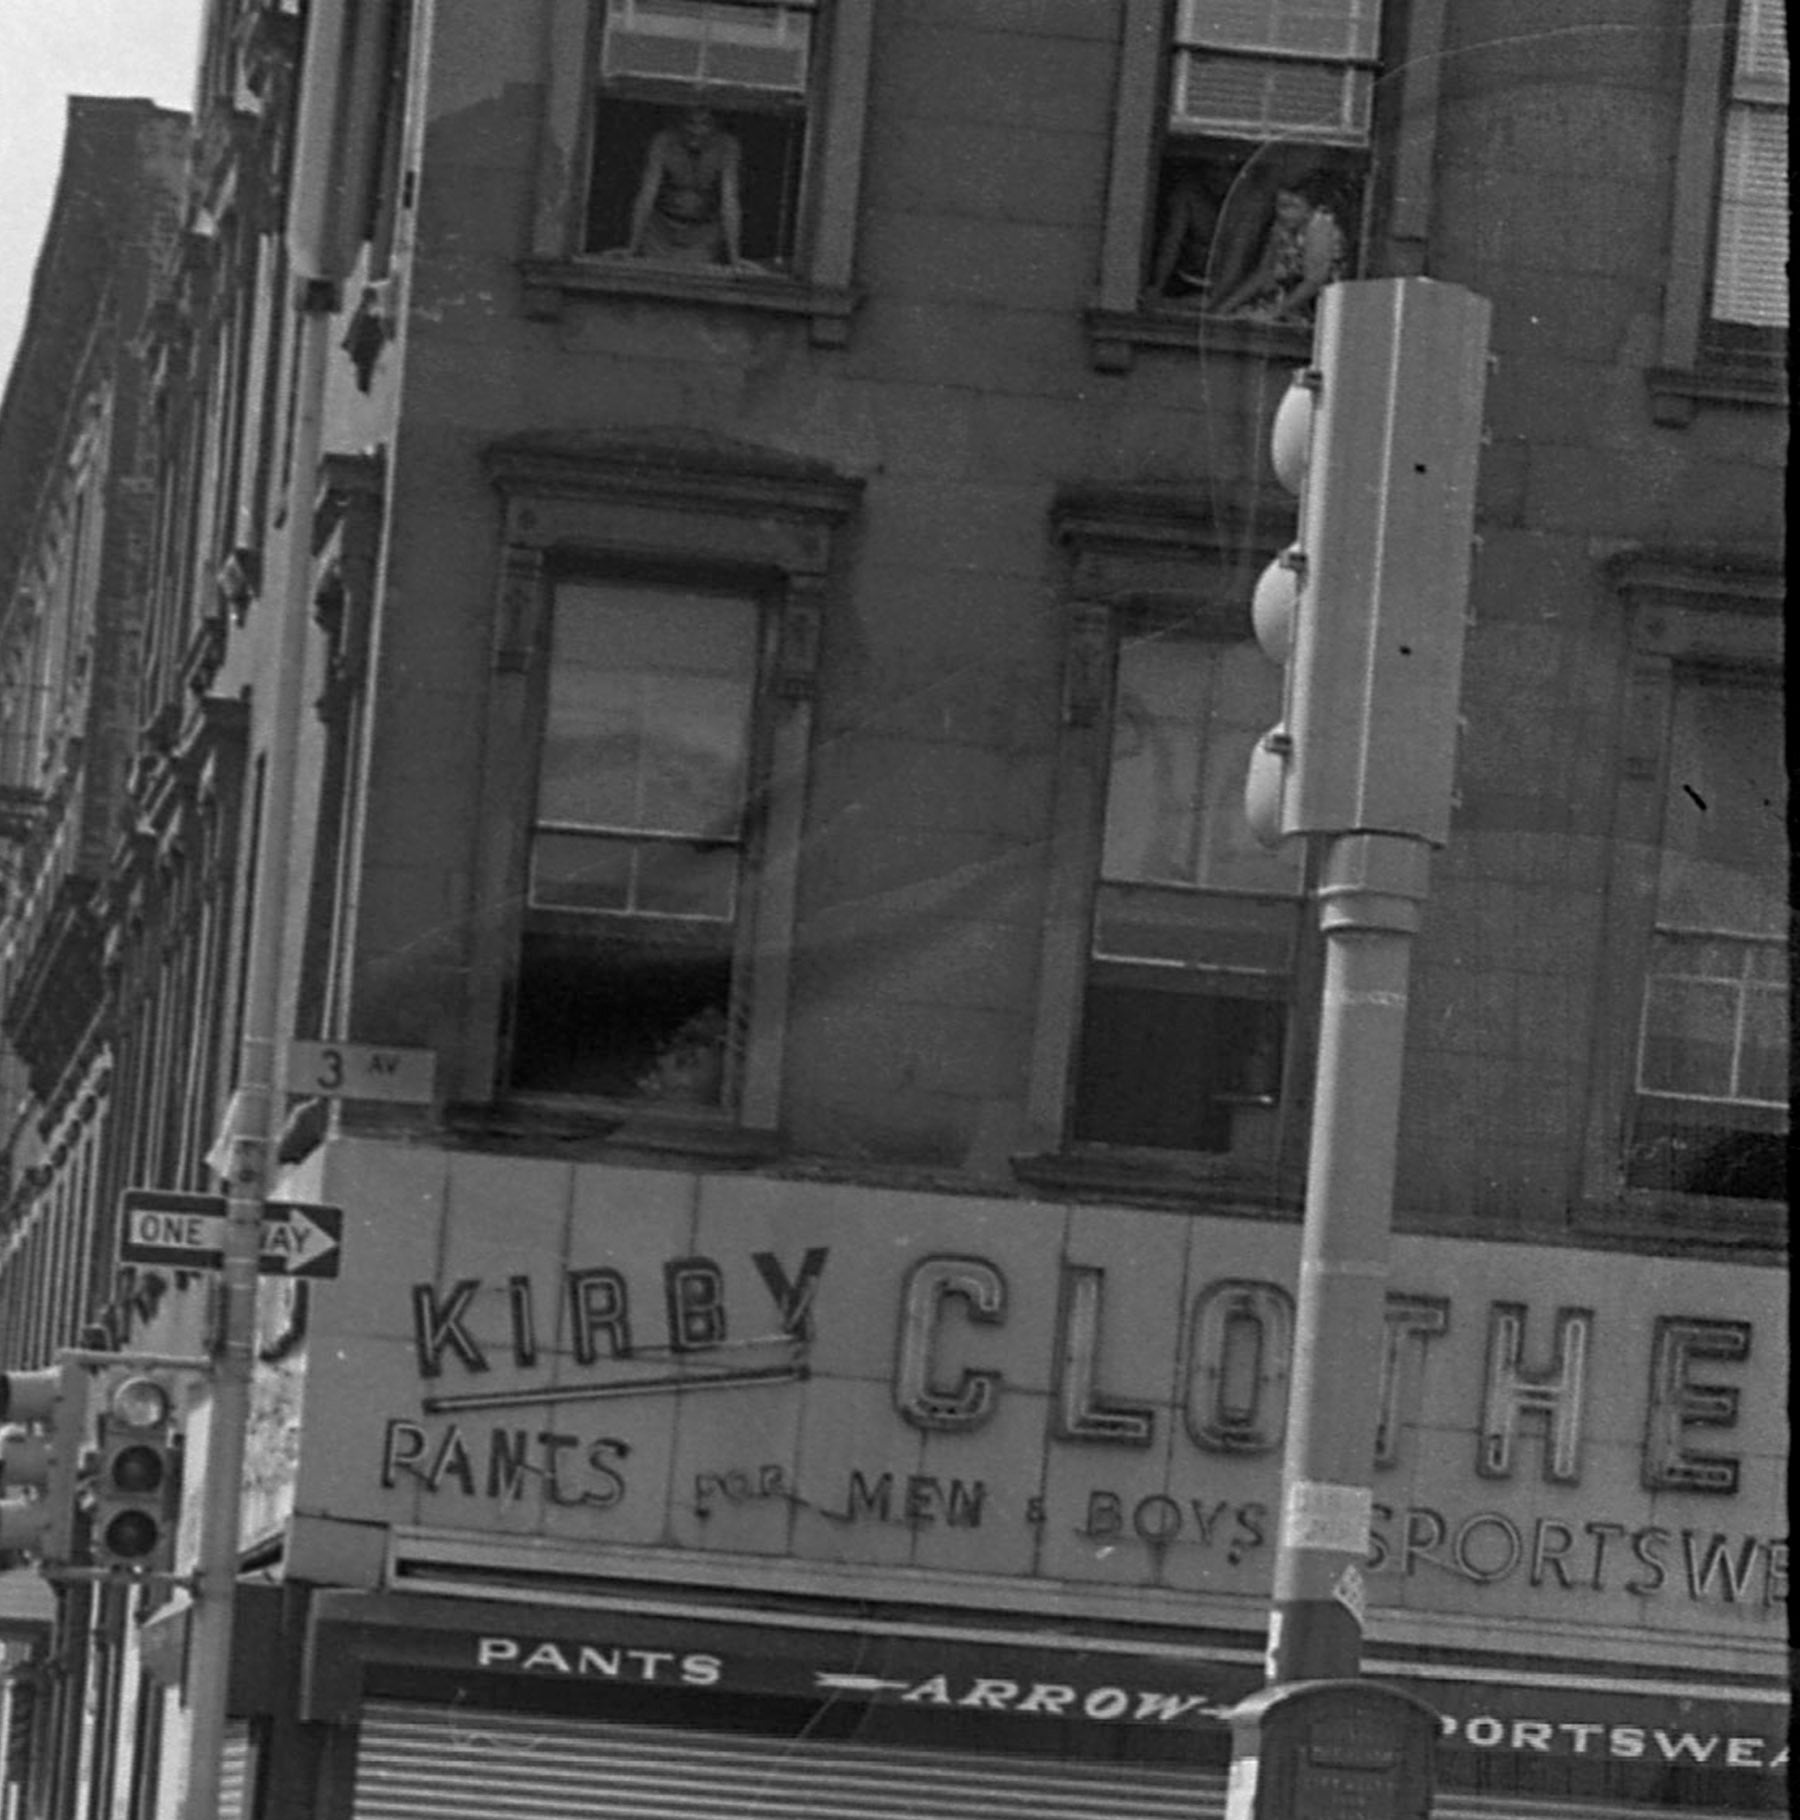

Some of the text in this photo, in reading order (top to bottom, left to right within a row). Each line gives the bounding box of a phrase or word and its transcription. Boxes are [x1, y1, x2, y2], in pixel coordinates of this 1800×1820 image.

[317, 1049, 343, 1090] 3
[140, 1214, 311, 1254] ONE AY
[413, 1247, 830, 1378] KIRBY
[380, 1418, 632, 1508] PANTS
[846, 1470, 986, 1528] MEN
[1085, 1490, 1268, 1549] BOYS
[477, 1637, 1790, 1768] PANTS ARROW ORTSWE
